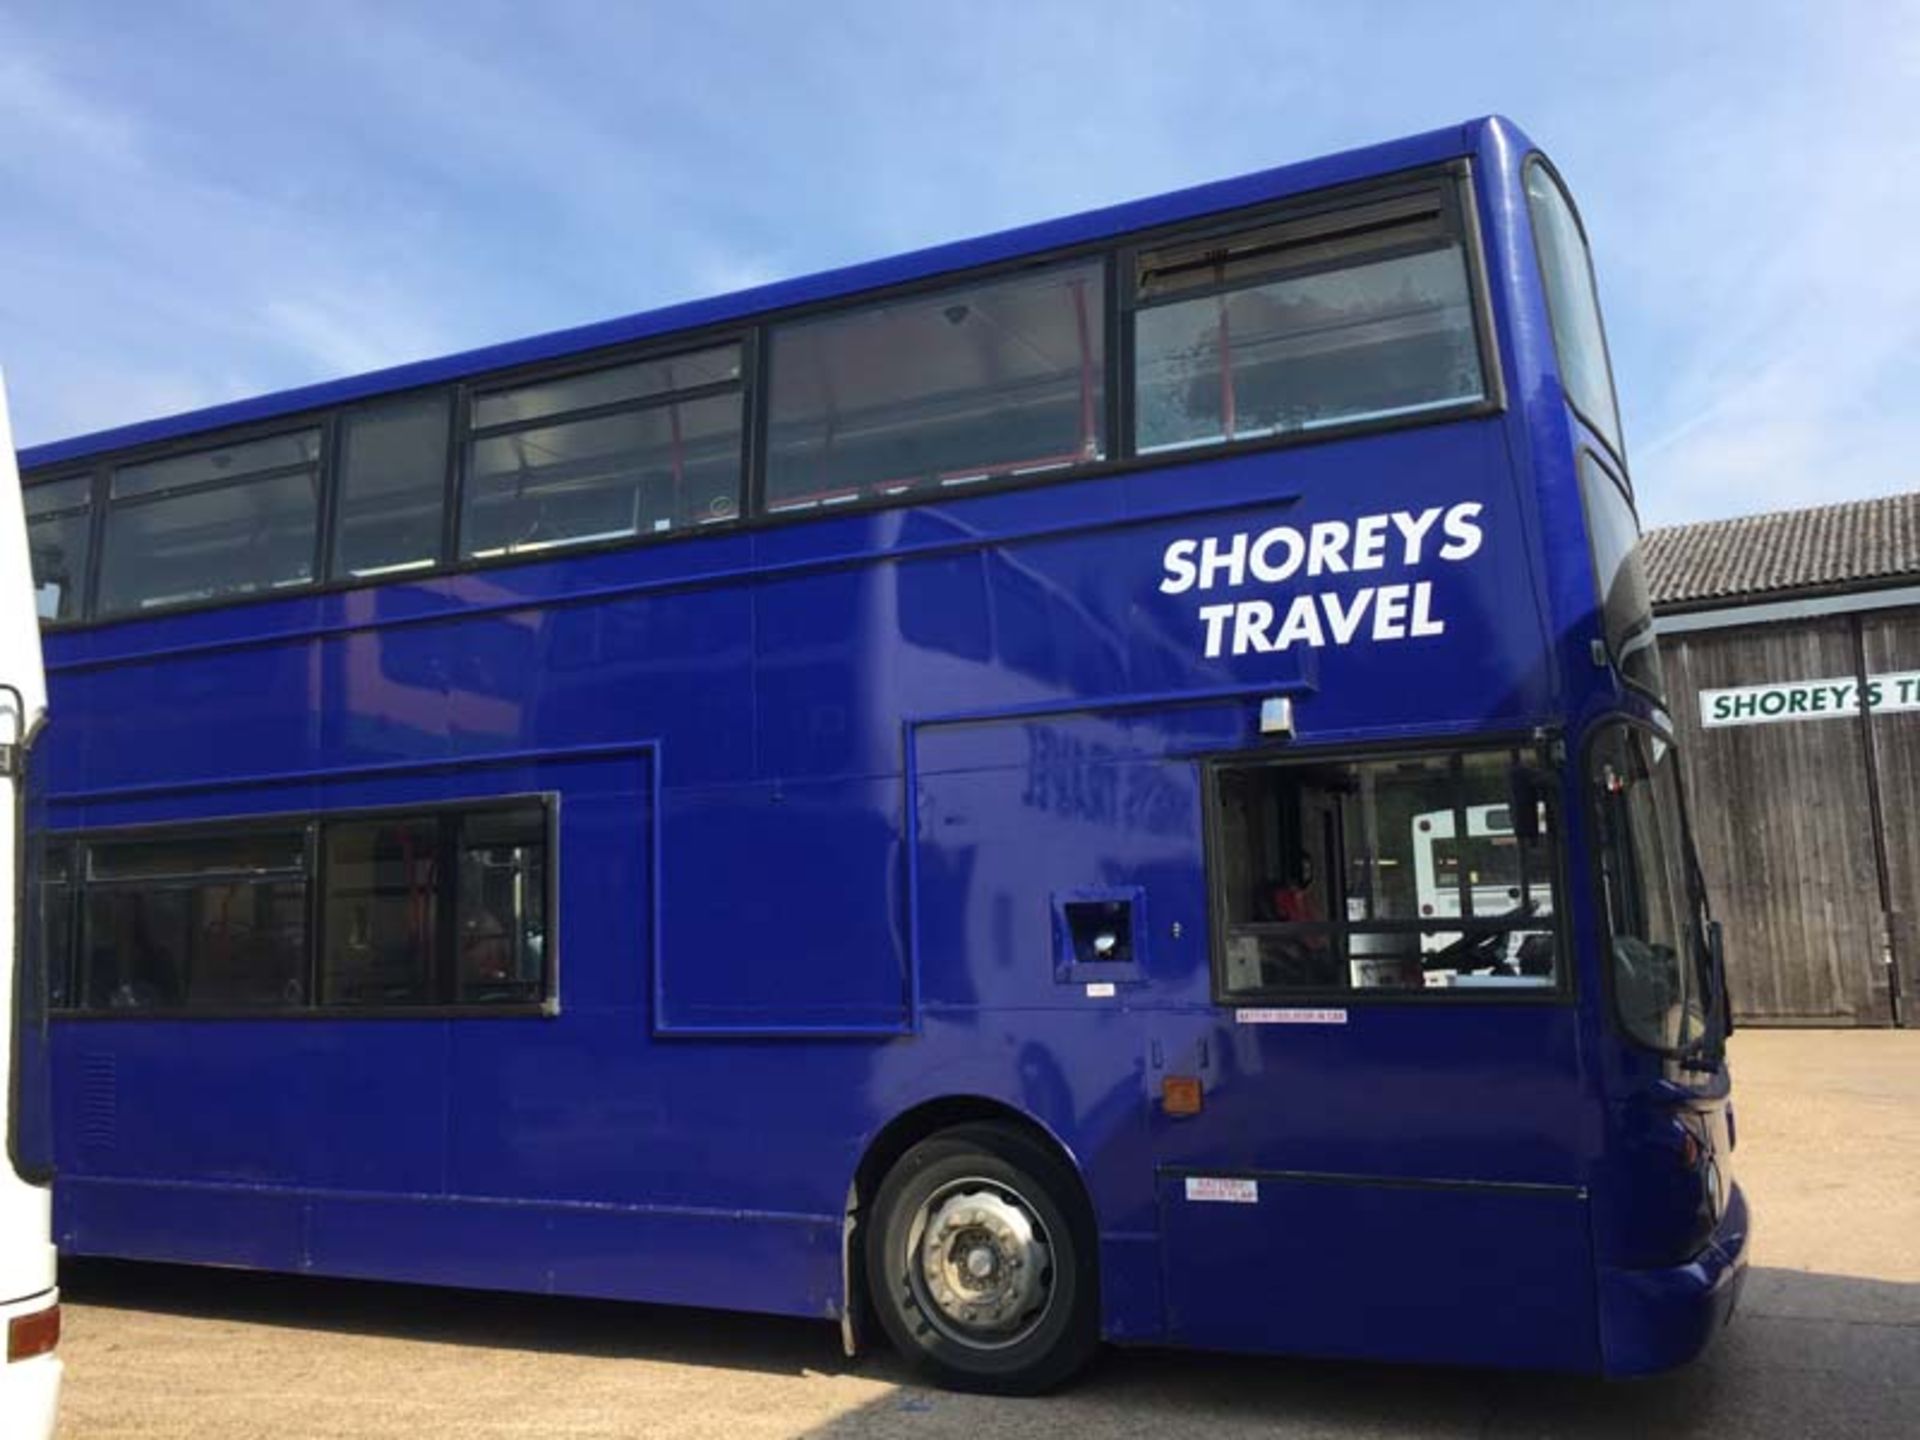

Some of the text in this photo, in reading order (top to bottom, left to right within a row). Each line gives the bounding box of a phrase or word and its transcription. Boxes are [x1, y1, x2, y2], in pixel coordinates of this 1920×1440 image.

[1159, 502, 1483, 594] SHOREYS
[1199, 581, 1445, 658] TRAVEL
[1713, 678, 1920, 719] SHOREYS T
